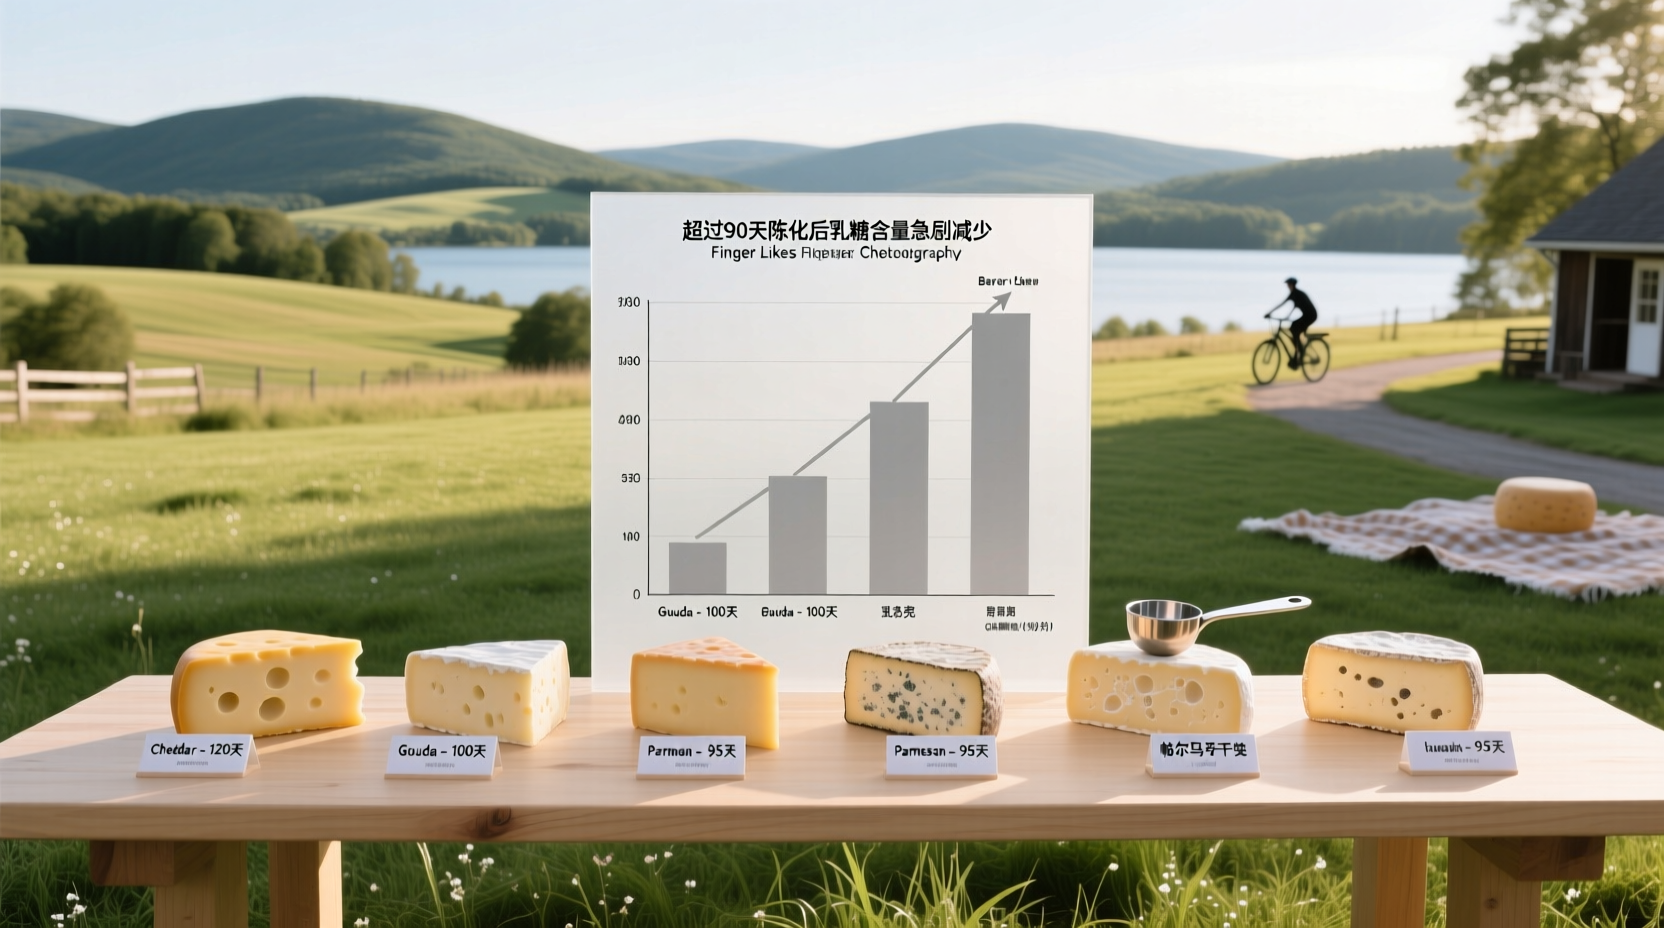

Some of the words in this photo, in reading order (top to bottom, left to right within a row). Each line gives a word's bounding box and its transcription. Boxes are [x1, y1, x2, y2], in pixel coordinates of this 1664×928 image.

[711, 245, 757, 262] Finger
[761, 244, 797, 260] Likes
[632, 588, 641, 600] 0
[705, 605, 738, 619] 100天
[806, 605, 838, 619] 100天
[209, 742, 244, 757] 120天
[398, 743, 438, 758] Gouda
[451, 744, 487, 759] 100天
[707, 743, 737, 759] 95天
[959, 744, 989, 759] 95天
[1474, 739, 1506, 754] 95天
